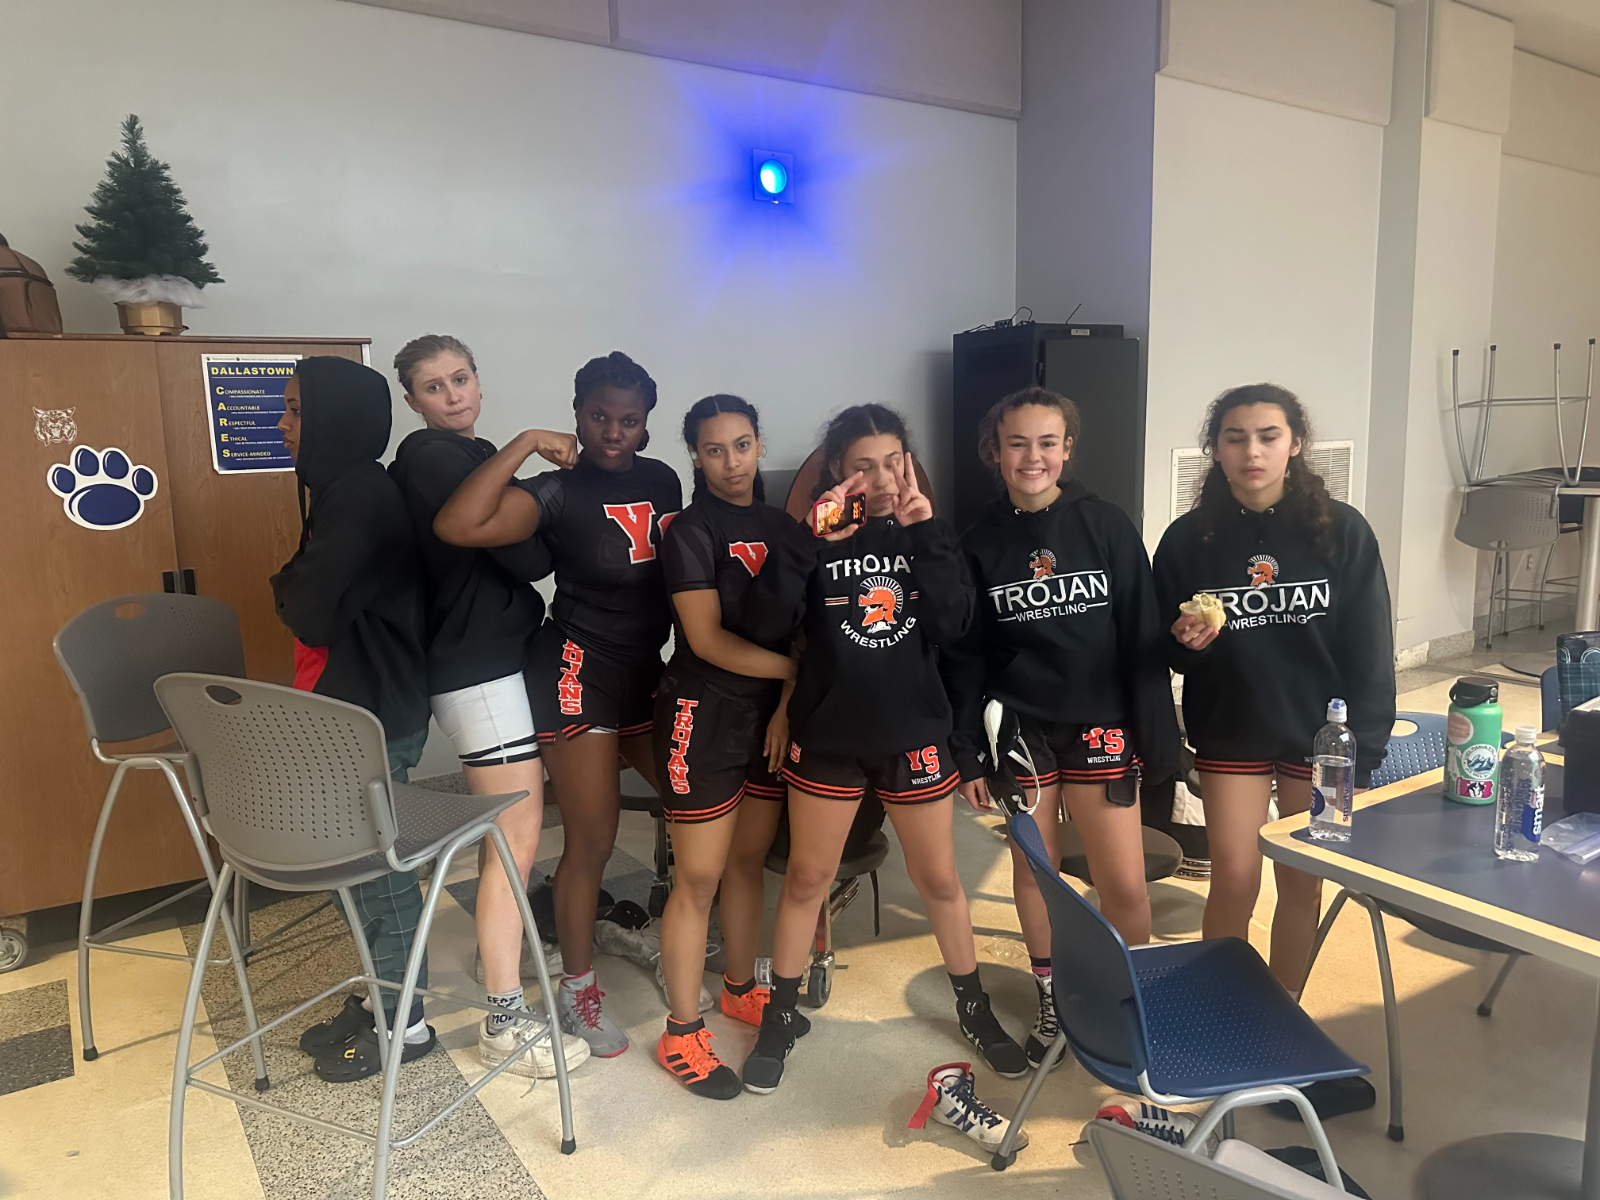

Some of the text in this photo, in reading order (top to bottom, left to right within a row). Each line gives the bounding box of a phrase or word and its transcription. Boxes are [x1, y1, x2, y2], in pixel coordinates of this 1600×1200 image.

[211, 367, 294, 375] DALLASTOWN
[216, 386, 265, 395] COMPASSIONATE
[217, 402, 260, 411] ACCOUNTABLE
[219, 418, 256, 426] RESPECTFUL
[826, 554, 914, 580] TROJA
[988, 574, 1108, 613] TROJAN
[1016, 603, 1087, 622] WRESTLING
[1227, 614, 1308, 630] WRESTLING
[840, 616, 917, 648] WRESTLING
[668, 698, 699, 794] TROJANS
[905, 745, 940, 774] YS
[1532, 784, 1545, 835] smart
